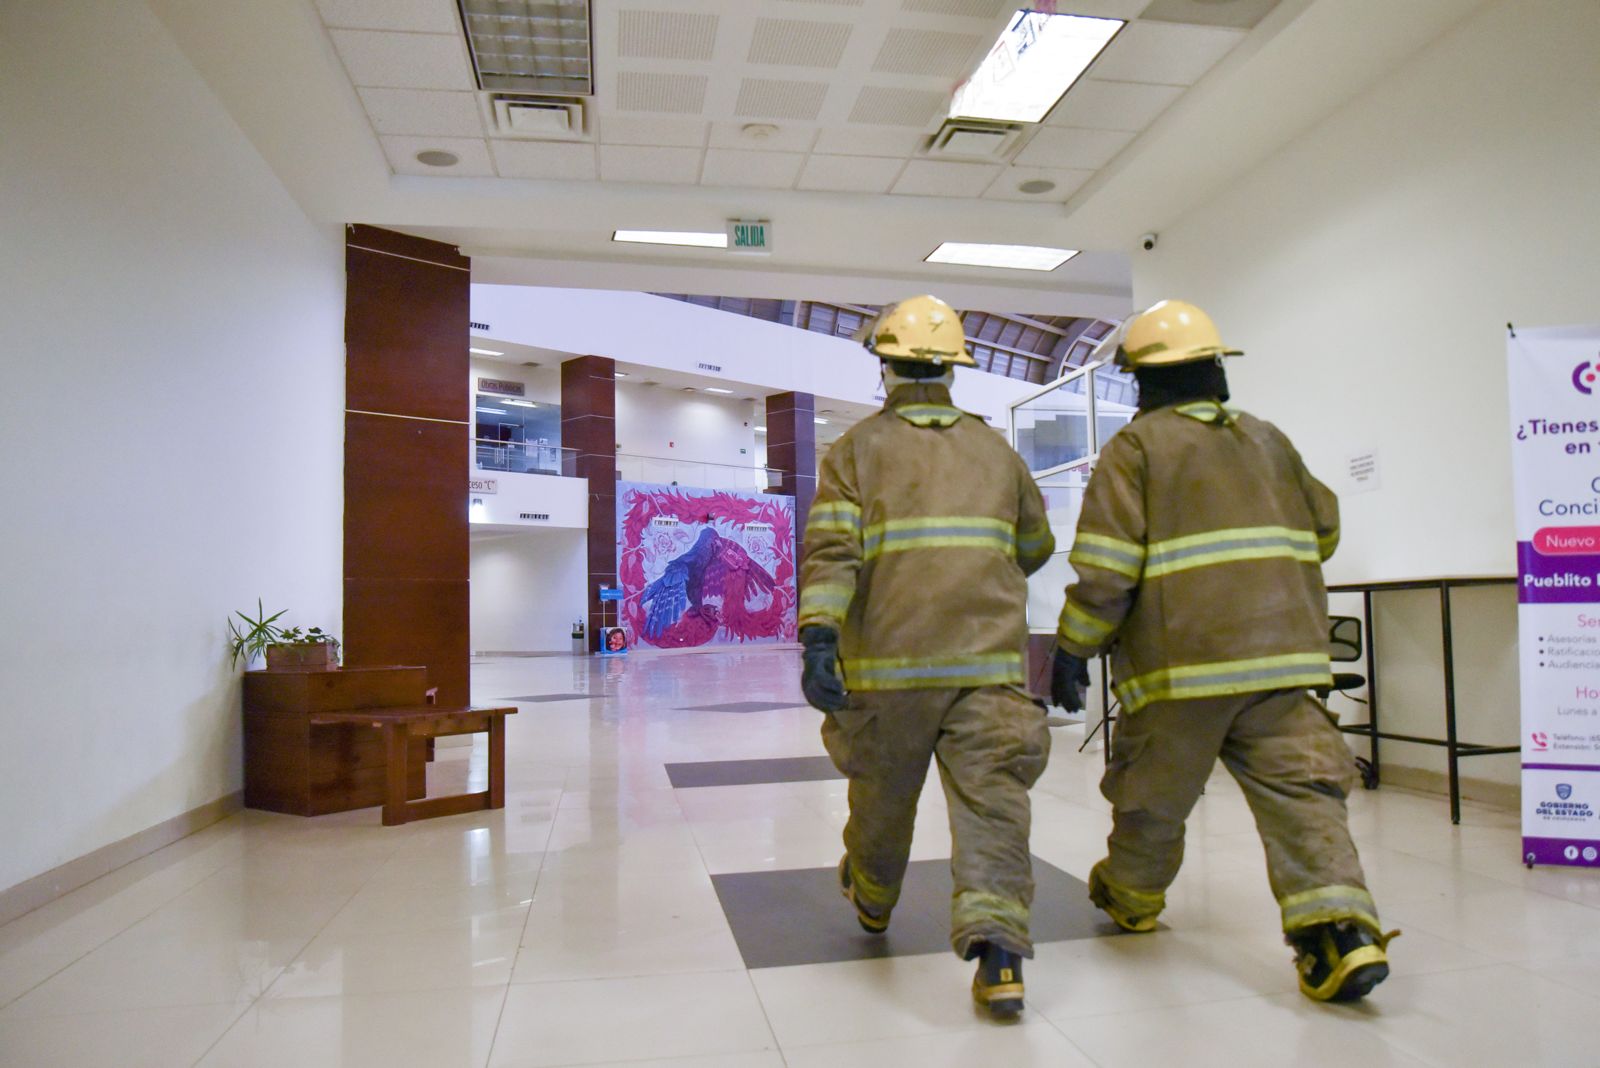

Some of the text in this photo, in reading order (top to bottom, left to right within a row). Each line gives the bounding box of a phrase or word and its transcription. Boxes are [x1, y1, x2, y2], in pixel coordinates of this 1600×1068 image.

[735, 225, 765, 247] SALIDA
[1516, 418, 1600, 441] ¿Tienes
[1565, 442, 1591, 454] en
[1545, 535, 1596, 548] Nuevo
[1523, 573, 1592, 587] Pueblito
[1557, 706, 1589, 716] Lunes
[1540, 801, 1589, 810] GOBIERNO
[1555, 808, 1593, 817] ESTADO
